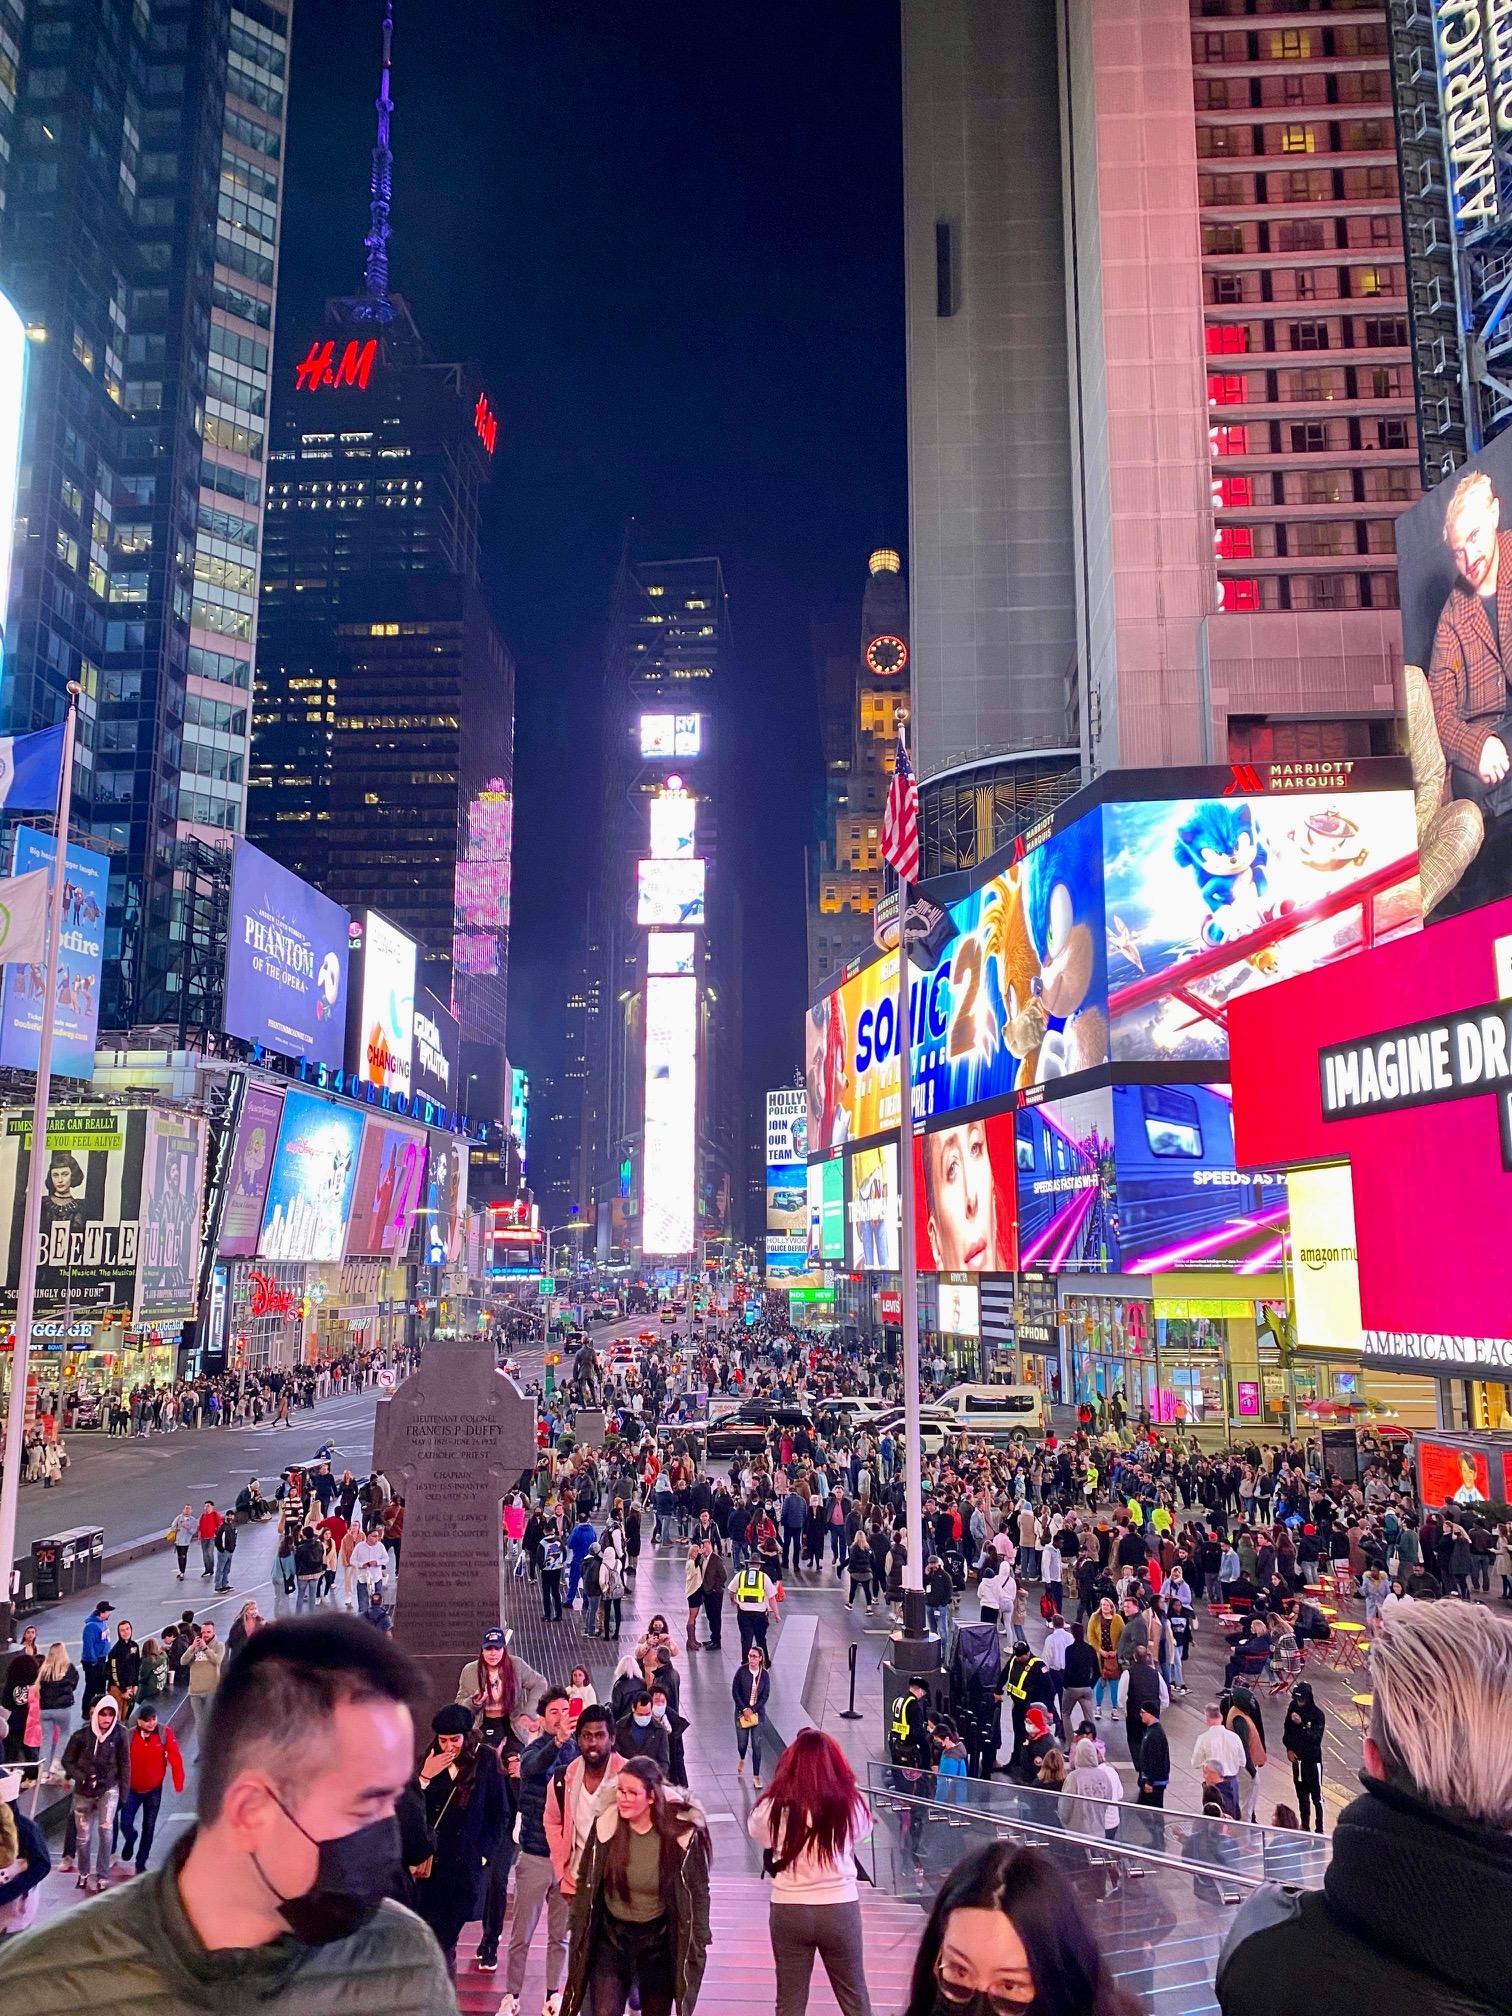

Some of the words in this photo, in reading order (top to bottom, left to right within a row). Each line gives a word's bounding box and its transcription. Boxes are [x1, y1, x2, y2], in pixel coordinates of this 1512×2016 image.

[295, 339, 377, 391] H&M
[1271, 762, 1354, 775] MARRIOTT
[1271, 775, 1345, 788] MARQUIS
[1026, 813, 1055, 840] MARRIOTT
[1026, 827, 1052, 851] MARQUIS
[30, 846, 40, 857] Big
[41, 850, 57, 862] heart
[64, 861, 78, 870] gger
[79, 864, 99, 877] laughs.
[877, 893, 899, 913] MARRIOT
[244, 915, 315, 979] PHANTOM
[349, 939, 361, 948] LG
[253, 956, 263, 971] OF
[266, 962, 280, 980] THE
[282, 973, 305, 993] OPERA
[950, 938, 984, 1057] 2
[367, 1044, 410, 1079] CHANGING
[1325, 1028, 1452, 1110] IMAGINE
[1457, 1016, 1512, 1085] DR
[769, 1092, 807, 1107] HOLLY
[911, 1083, 927, 1118] PRIL
[928, 1079, 935, 1115] 8
[367, 1081, 468, 1135] BROADWAY
[769, 1106, 798, 1115] POLICE
[10, 1121, 33, 1131] TIMES
[46, 1120, 64, 1130] UARE
[67, 1119, 82, 1129] CAN
[85, 1118, 115, 1129] REALLY
[769, 1120, 787, 1131] JOIN
[54, 1136, 69, 1147] YOU
[72, 1135, 91, 1146] FEEL
[95, 1135, 120, 1146] ALIVE!
[769, 1135, 786, 1145] OUR
[769, 1149, 792, 1160] TEAM
[1033, 1180, 1053, 1194] SPEEDS
[1054, 1179, 1060, 1191] AS
[1060, 1177, 1074, 1190] FAST
[1074, 1176, 1082, 1188] AS
[1193, 1171, 1250, 1185] SPEEDS
[394, 1143, 428, 1229] 21
[37, 1223, 137, 1266] BEETLE
[1300, 1248, 1340, 1262] amazon
[99, 1269, 111, 1277] The
[1026, 1273, 1043, 1281] SEPHORA
[61, 1288, 81, 1298] GOD
[10, 1324, 92, 1337] LGGAGE
[155, 1320, 185, 1331] LUGGAGE
[1363, 1331, 1466, 1362] AMERICAN
[1473, 1338, 1512, 1367] EAG
[412, 1415, 458, 1423] LIEUTENANT
[460, 1414, 496, 1423] COLONEL
[406, 1425, 452, 1435] FRANCIS
[417, 1451, 457, 1459] CATHOLIC
[461, 1451, 490, 1459] PRIEST
[433, 1471, 472, 1479] CHAPLAIN
